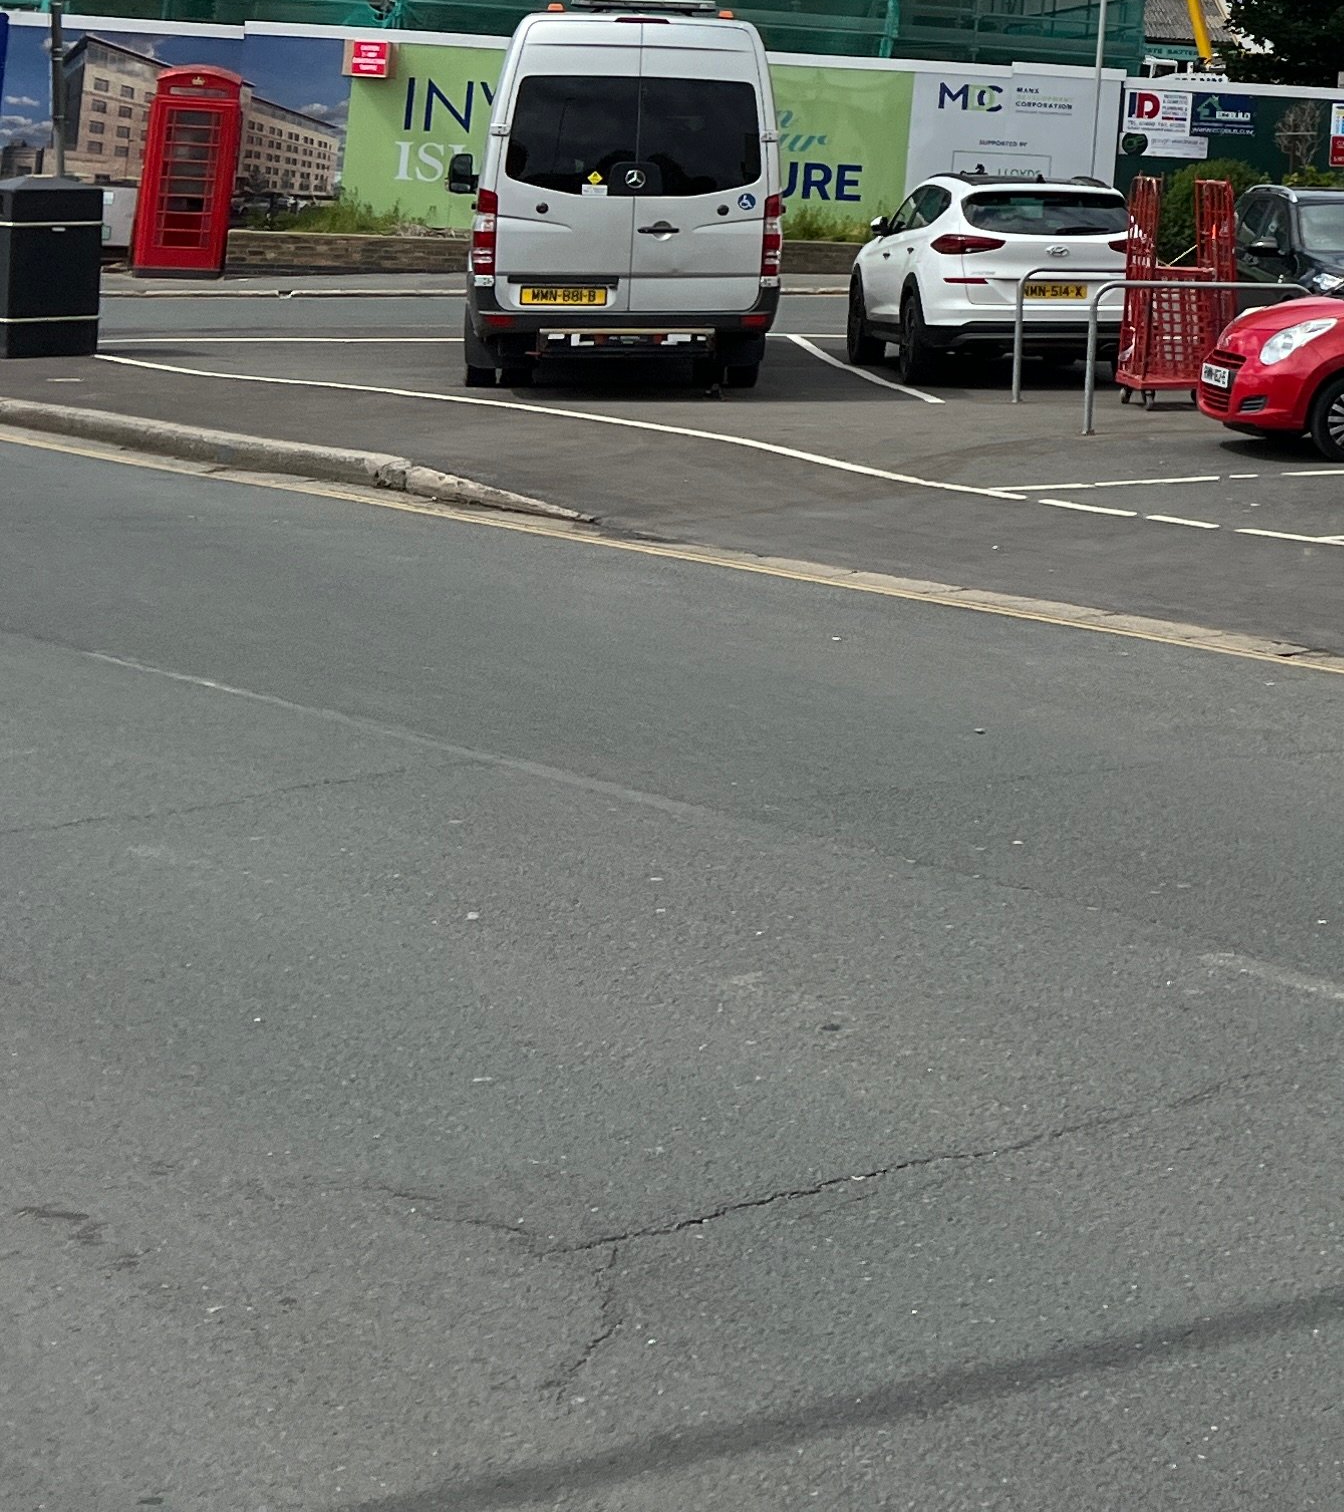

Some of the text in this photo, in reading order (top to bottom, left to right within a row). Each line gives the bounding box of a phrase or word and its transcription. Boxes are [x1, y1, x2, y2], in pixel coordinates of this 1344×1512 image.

[938, 82, 1003, 112] MDC
[1015, 101, 1073, 110] CORPORATION
[979, 140, 1018, 148] SUPPORTED
